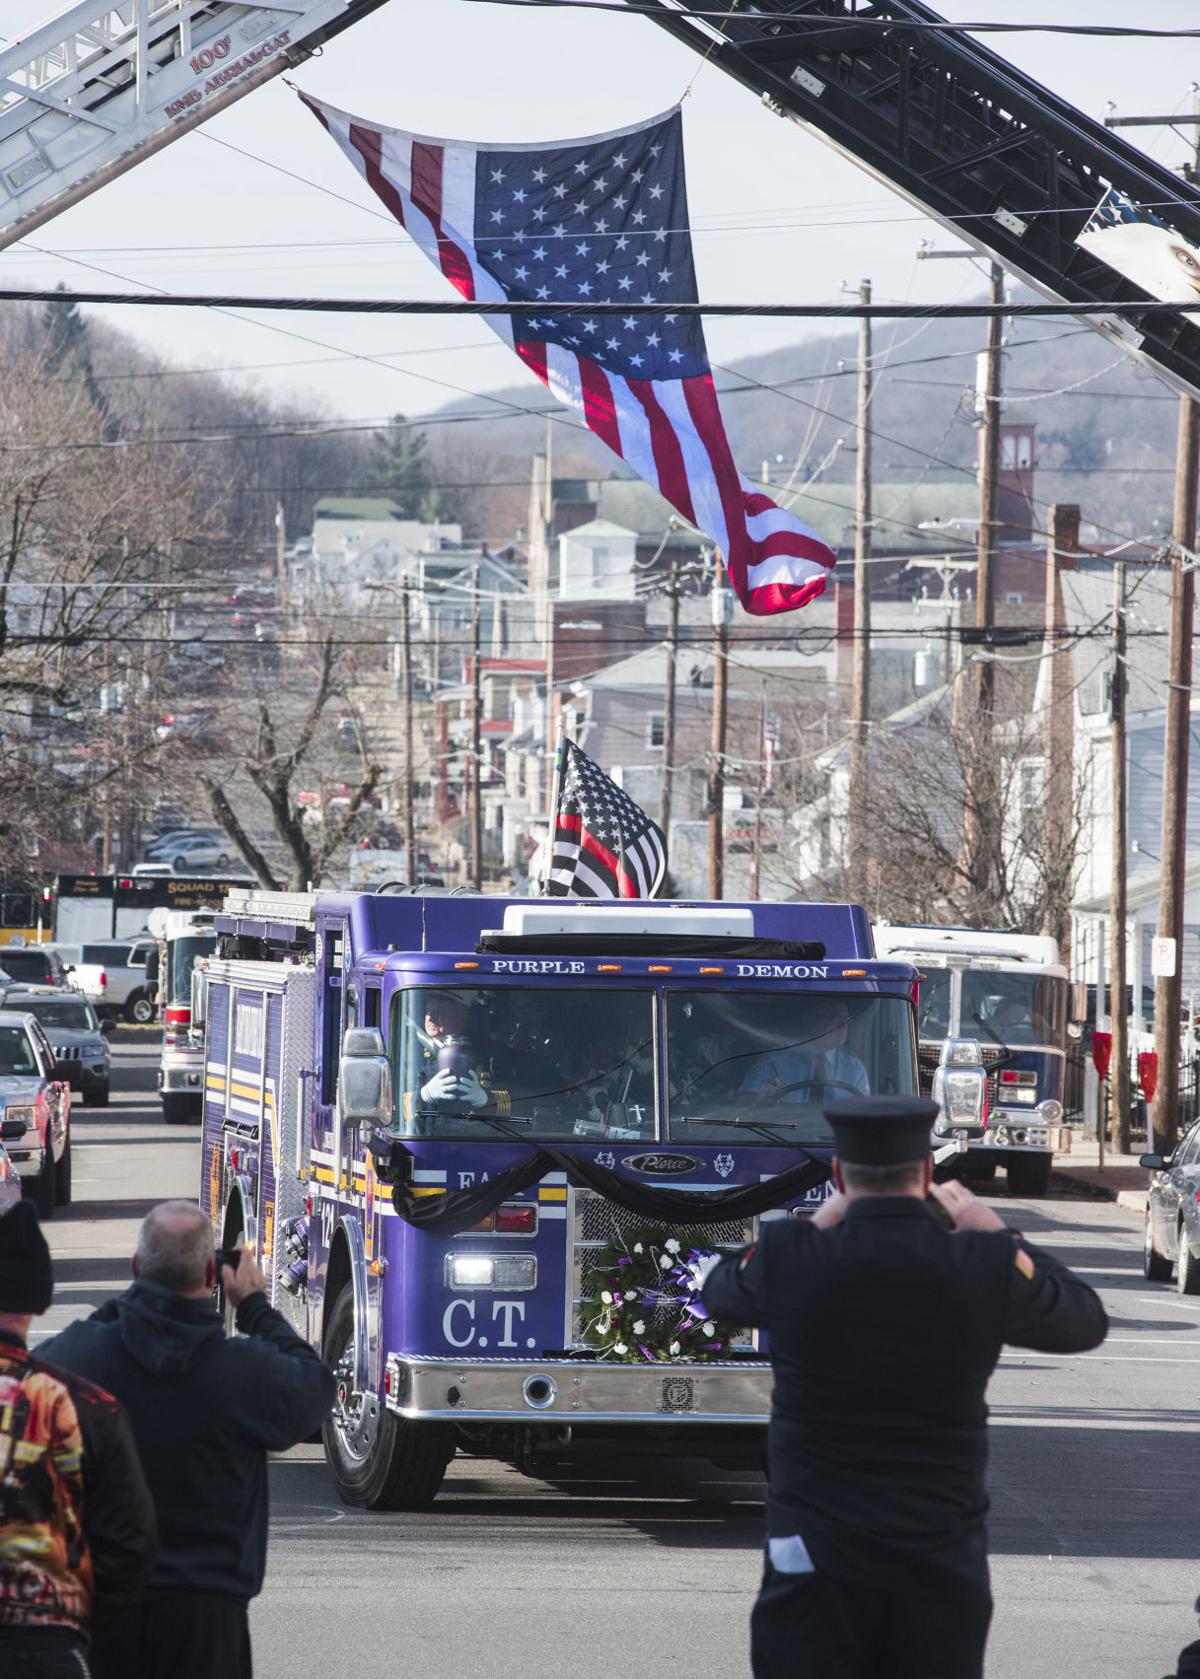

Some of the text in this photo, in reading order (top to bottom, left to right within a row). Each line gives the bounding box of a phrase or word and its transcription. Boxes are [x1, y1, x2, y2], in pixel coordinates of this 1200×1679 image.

[167, 882, 214, 894] SQUAD
[492, 960, 829, 978] PURPLE DEMON
[641, 1156, 687, 1171] Pierce
[442, 1298, 536, 1349] C.T.
